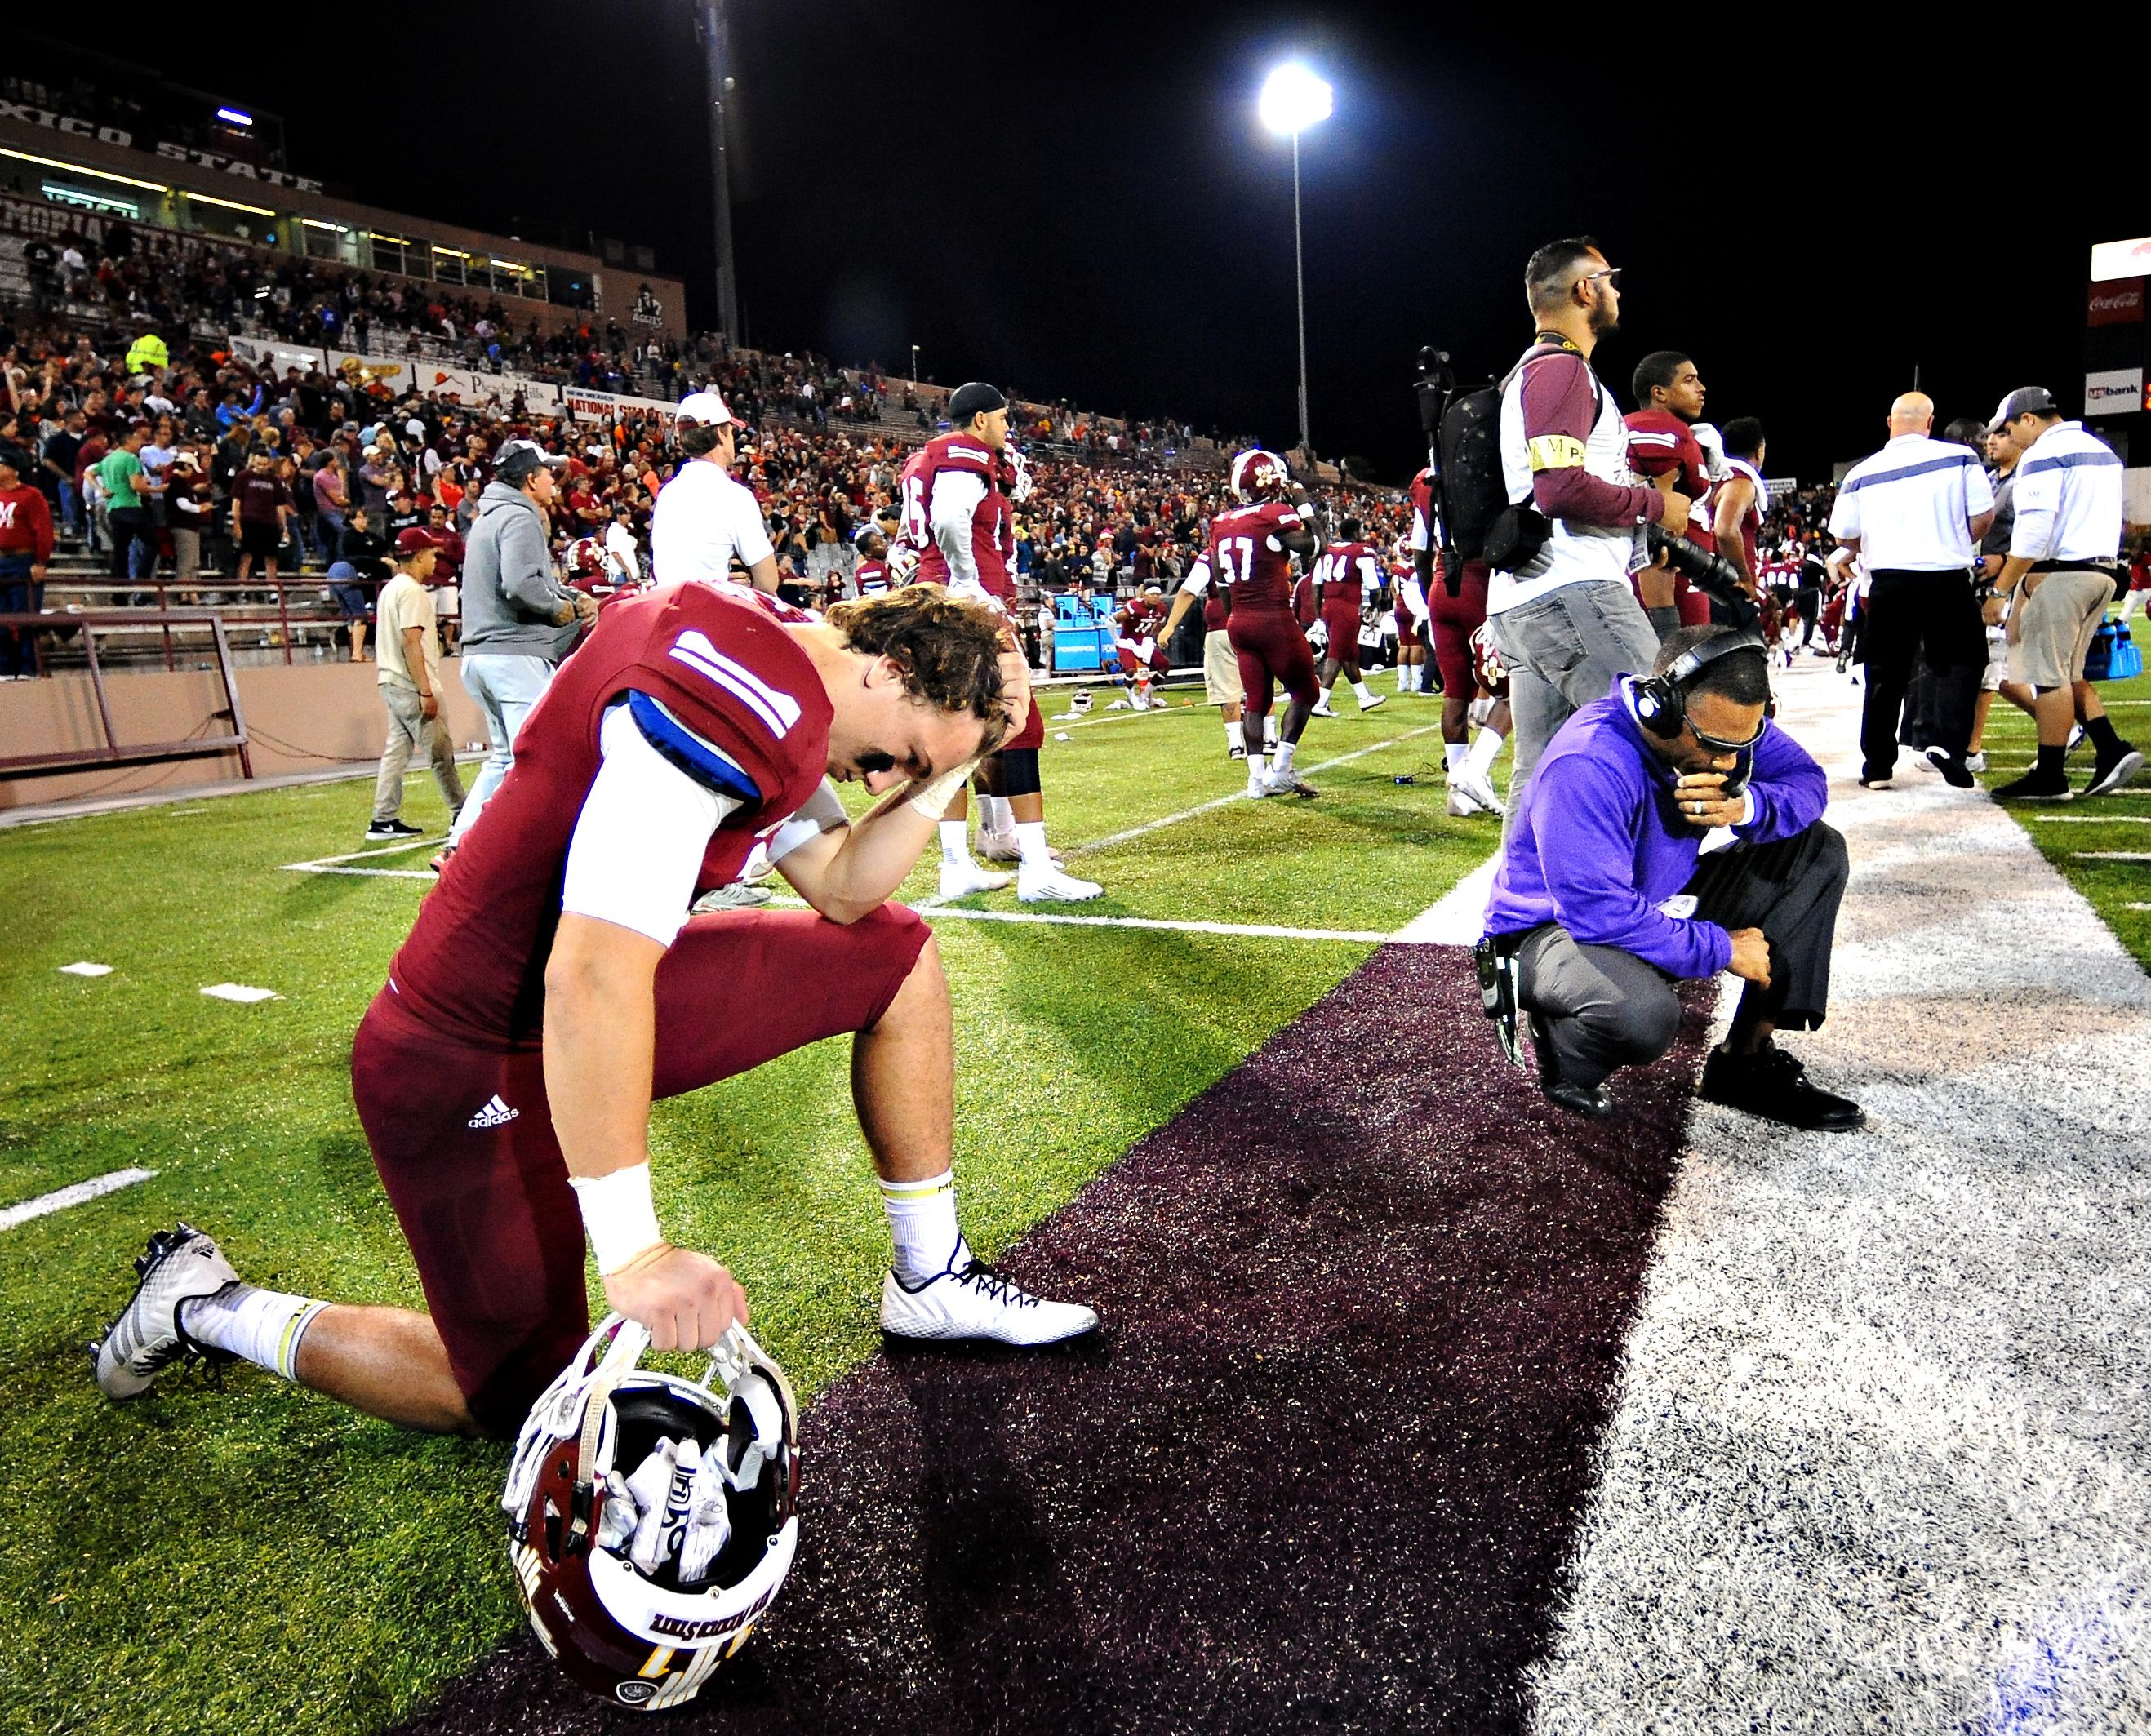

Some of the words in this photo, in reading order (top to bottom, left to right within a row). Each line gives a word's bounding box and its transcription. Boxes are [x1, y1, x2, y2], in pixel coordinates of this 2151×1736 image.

[156, 140, 324, 194] STATE
[1218, 536, 1254, 584] 57
[1322, 553, 1348, 582] 84
[468, 1108, 520, 1129] adidas
[648, 1613, 701, 1642] STATE
